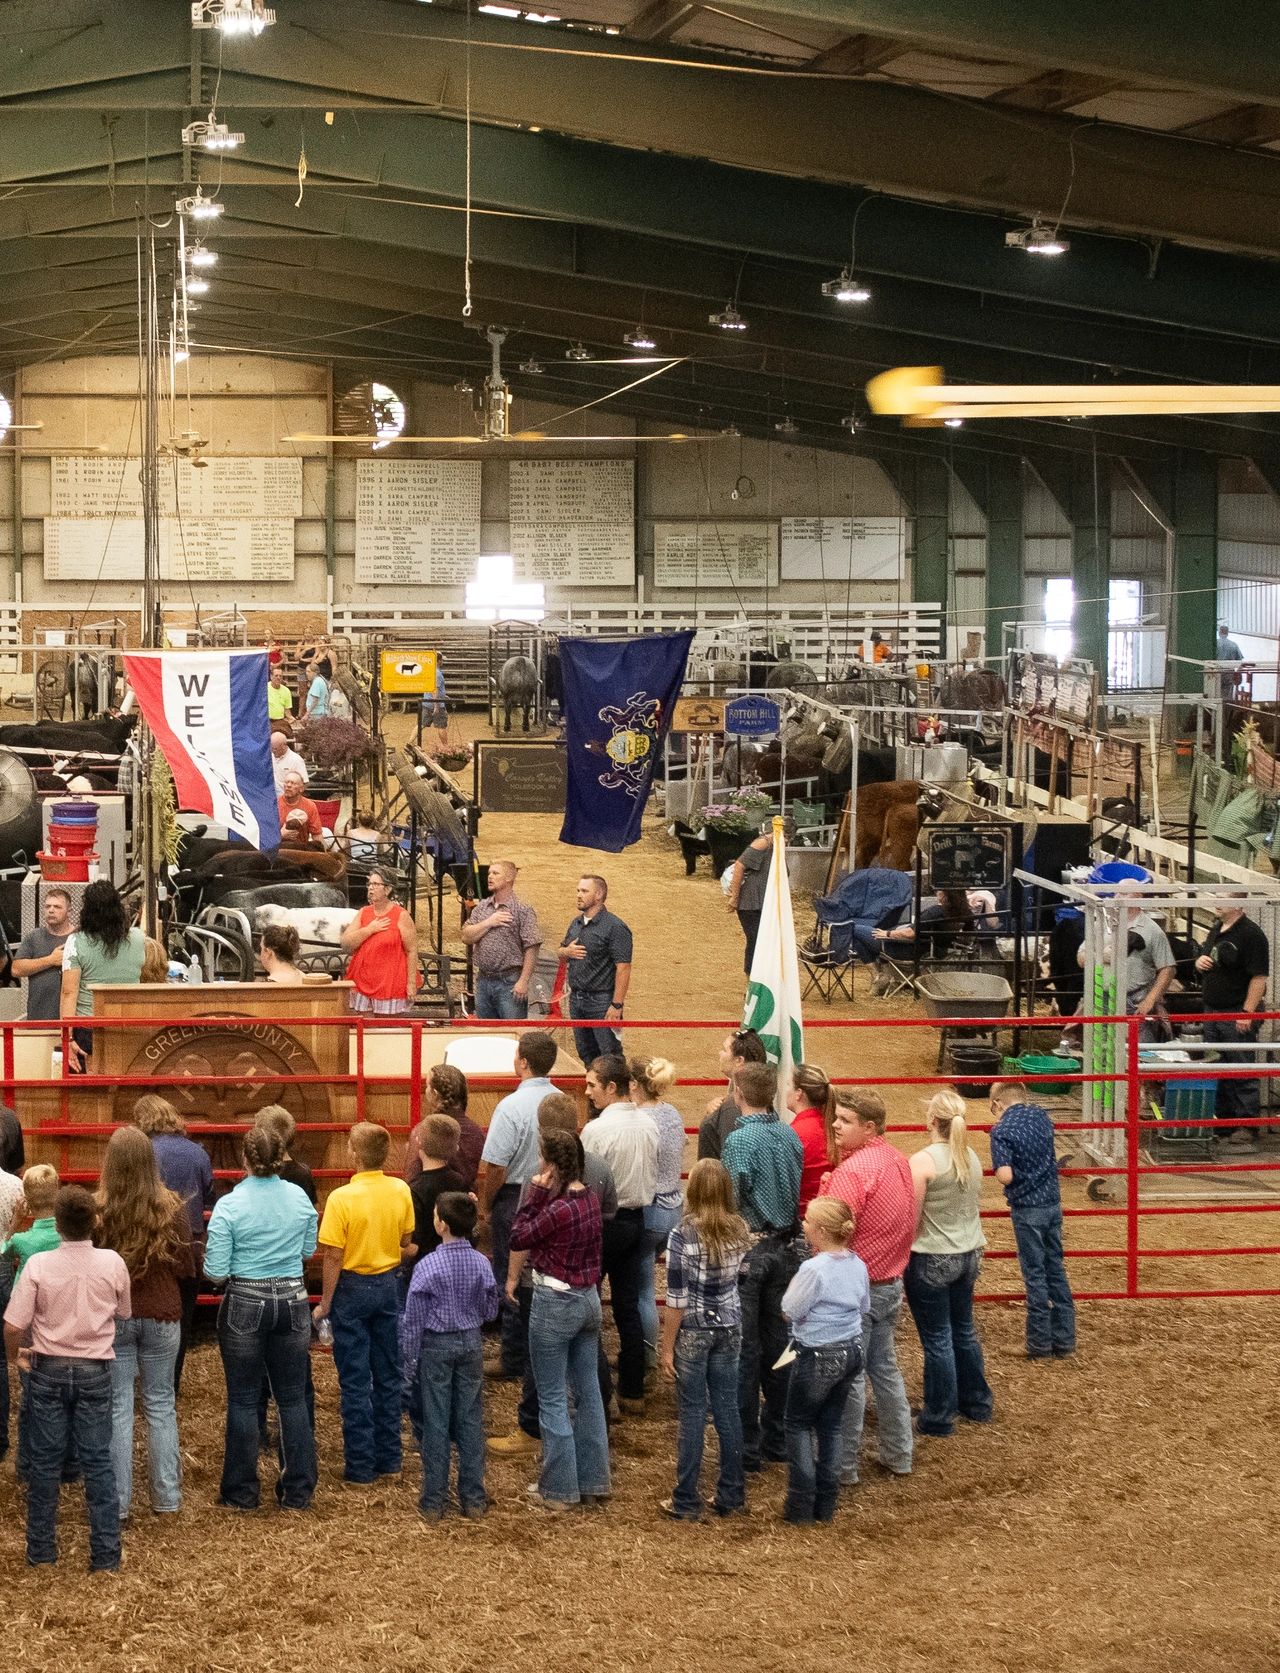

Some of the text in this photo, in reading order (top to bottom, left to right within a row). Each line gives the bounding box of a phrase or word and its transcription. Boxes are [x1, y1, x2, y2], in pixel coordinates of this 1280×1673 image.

[728, 708, 758, 719] BOTTOM
[759, 708, 776, 719] HILL
[145, 1024, 303, 1061] GREENE COUNTY
